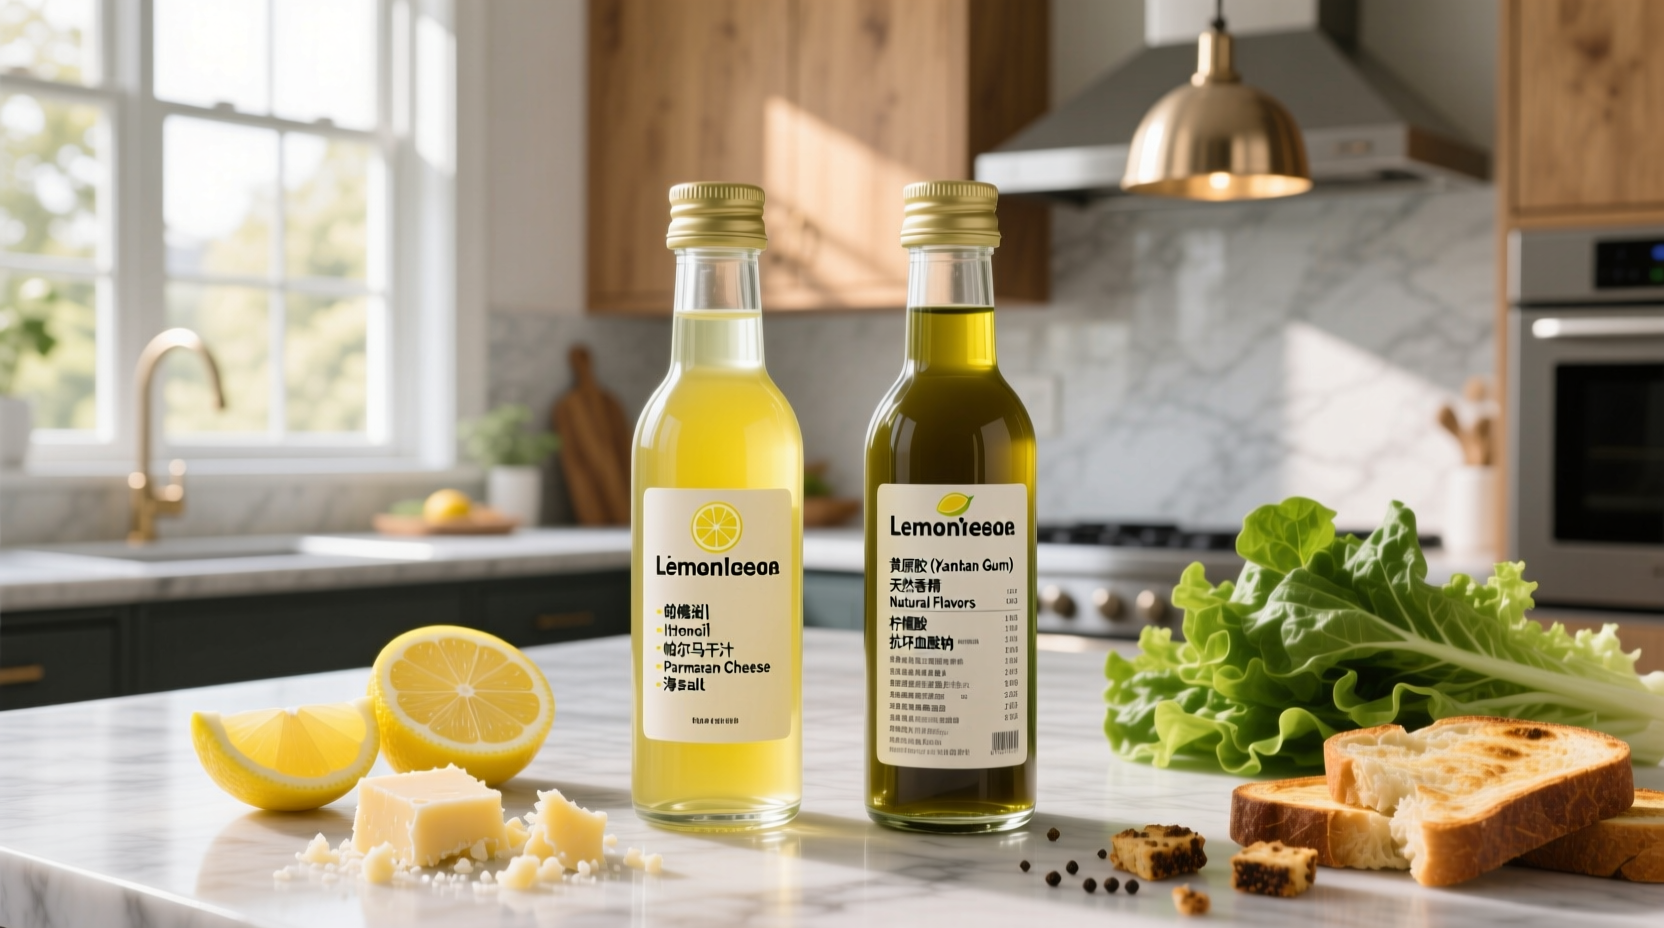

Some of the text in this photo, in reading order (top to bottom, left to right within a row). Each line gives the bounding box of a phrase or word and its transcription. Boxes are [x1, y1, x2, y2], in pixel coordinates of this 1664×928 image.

[982, 557, 1014, 574] Gum)
[933, 595, 976, 609] Flavors
[724, 660, 771, 674] Cheese
